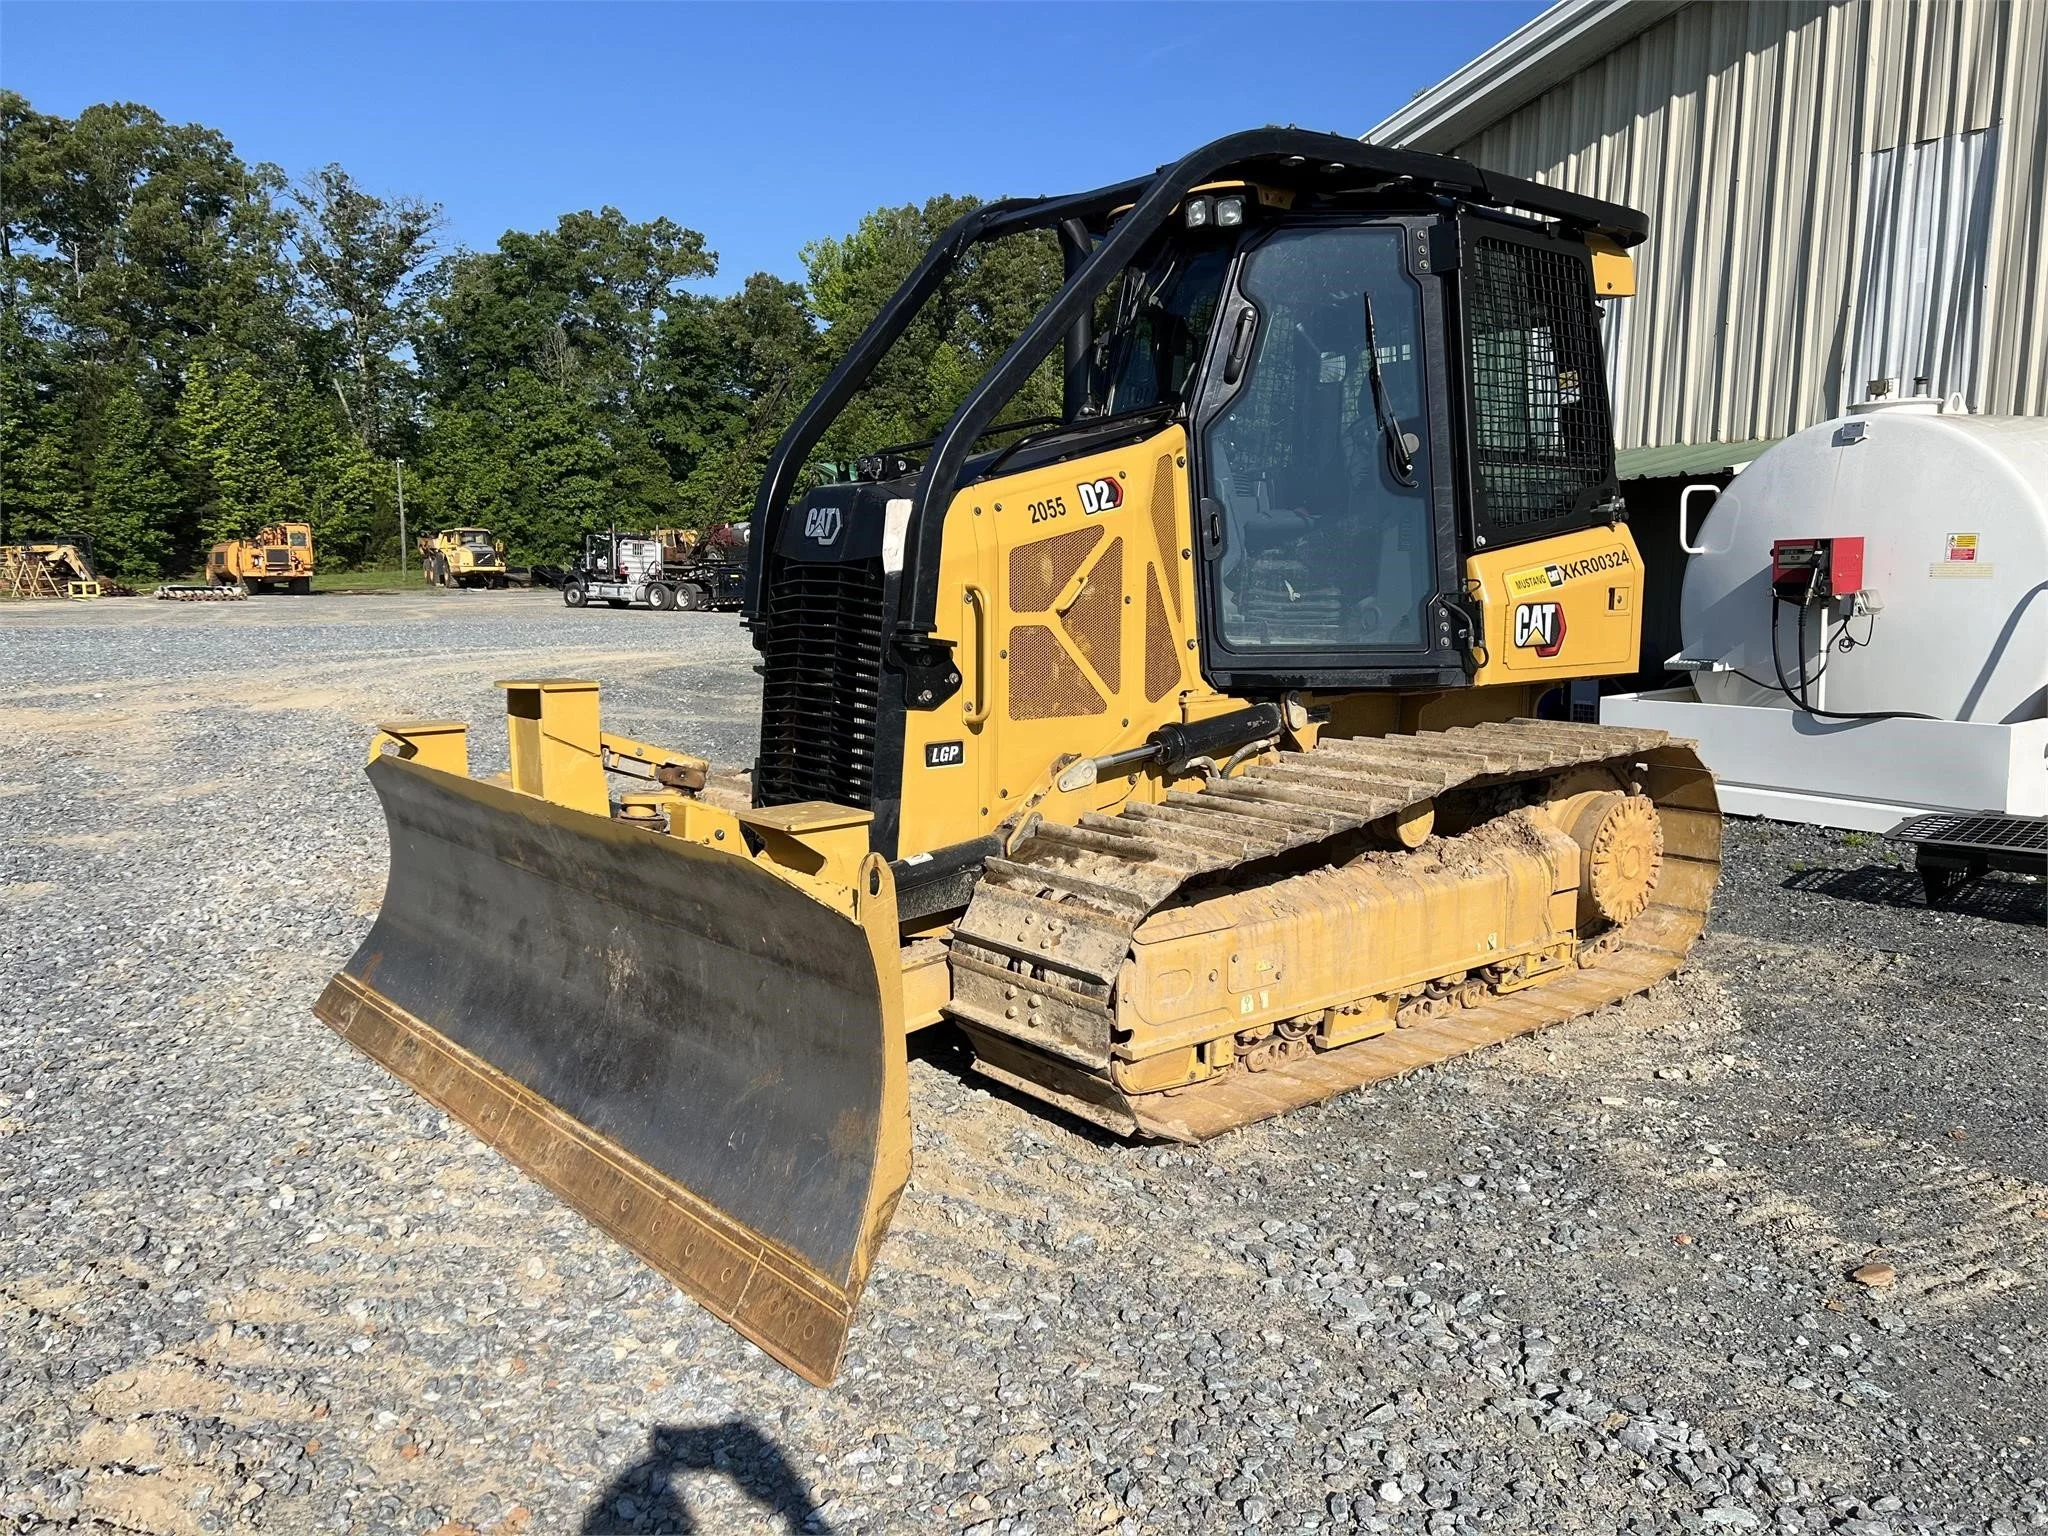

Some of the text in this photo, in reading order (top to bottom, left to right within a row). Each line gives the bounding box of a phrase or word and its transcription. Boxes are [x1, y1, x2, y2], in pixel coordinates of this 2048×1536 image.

[1028, 496, 1067, 524] 2055
[1077, 479, 1115, 515] D2
[805, 508, 835, 537] CAT
[1515, 574, 1547, 590] MUSTANG
[1559, 550, 1630, 581] XKR00324
[1515, 604, 1556, 648] CAT
[932, 746, 960, 763] LGP
